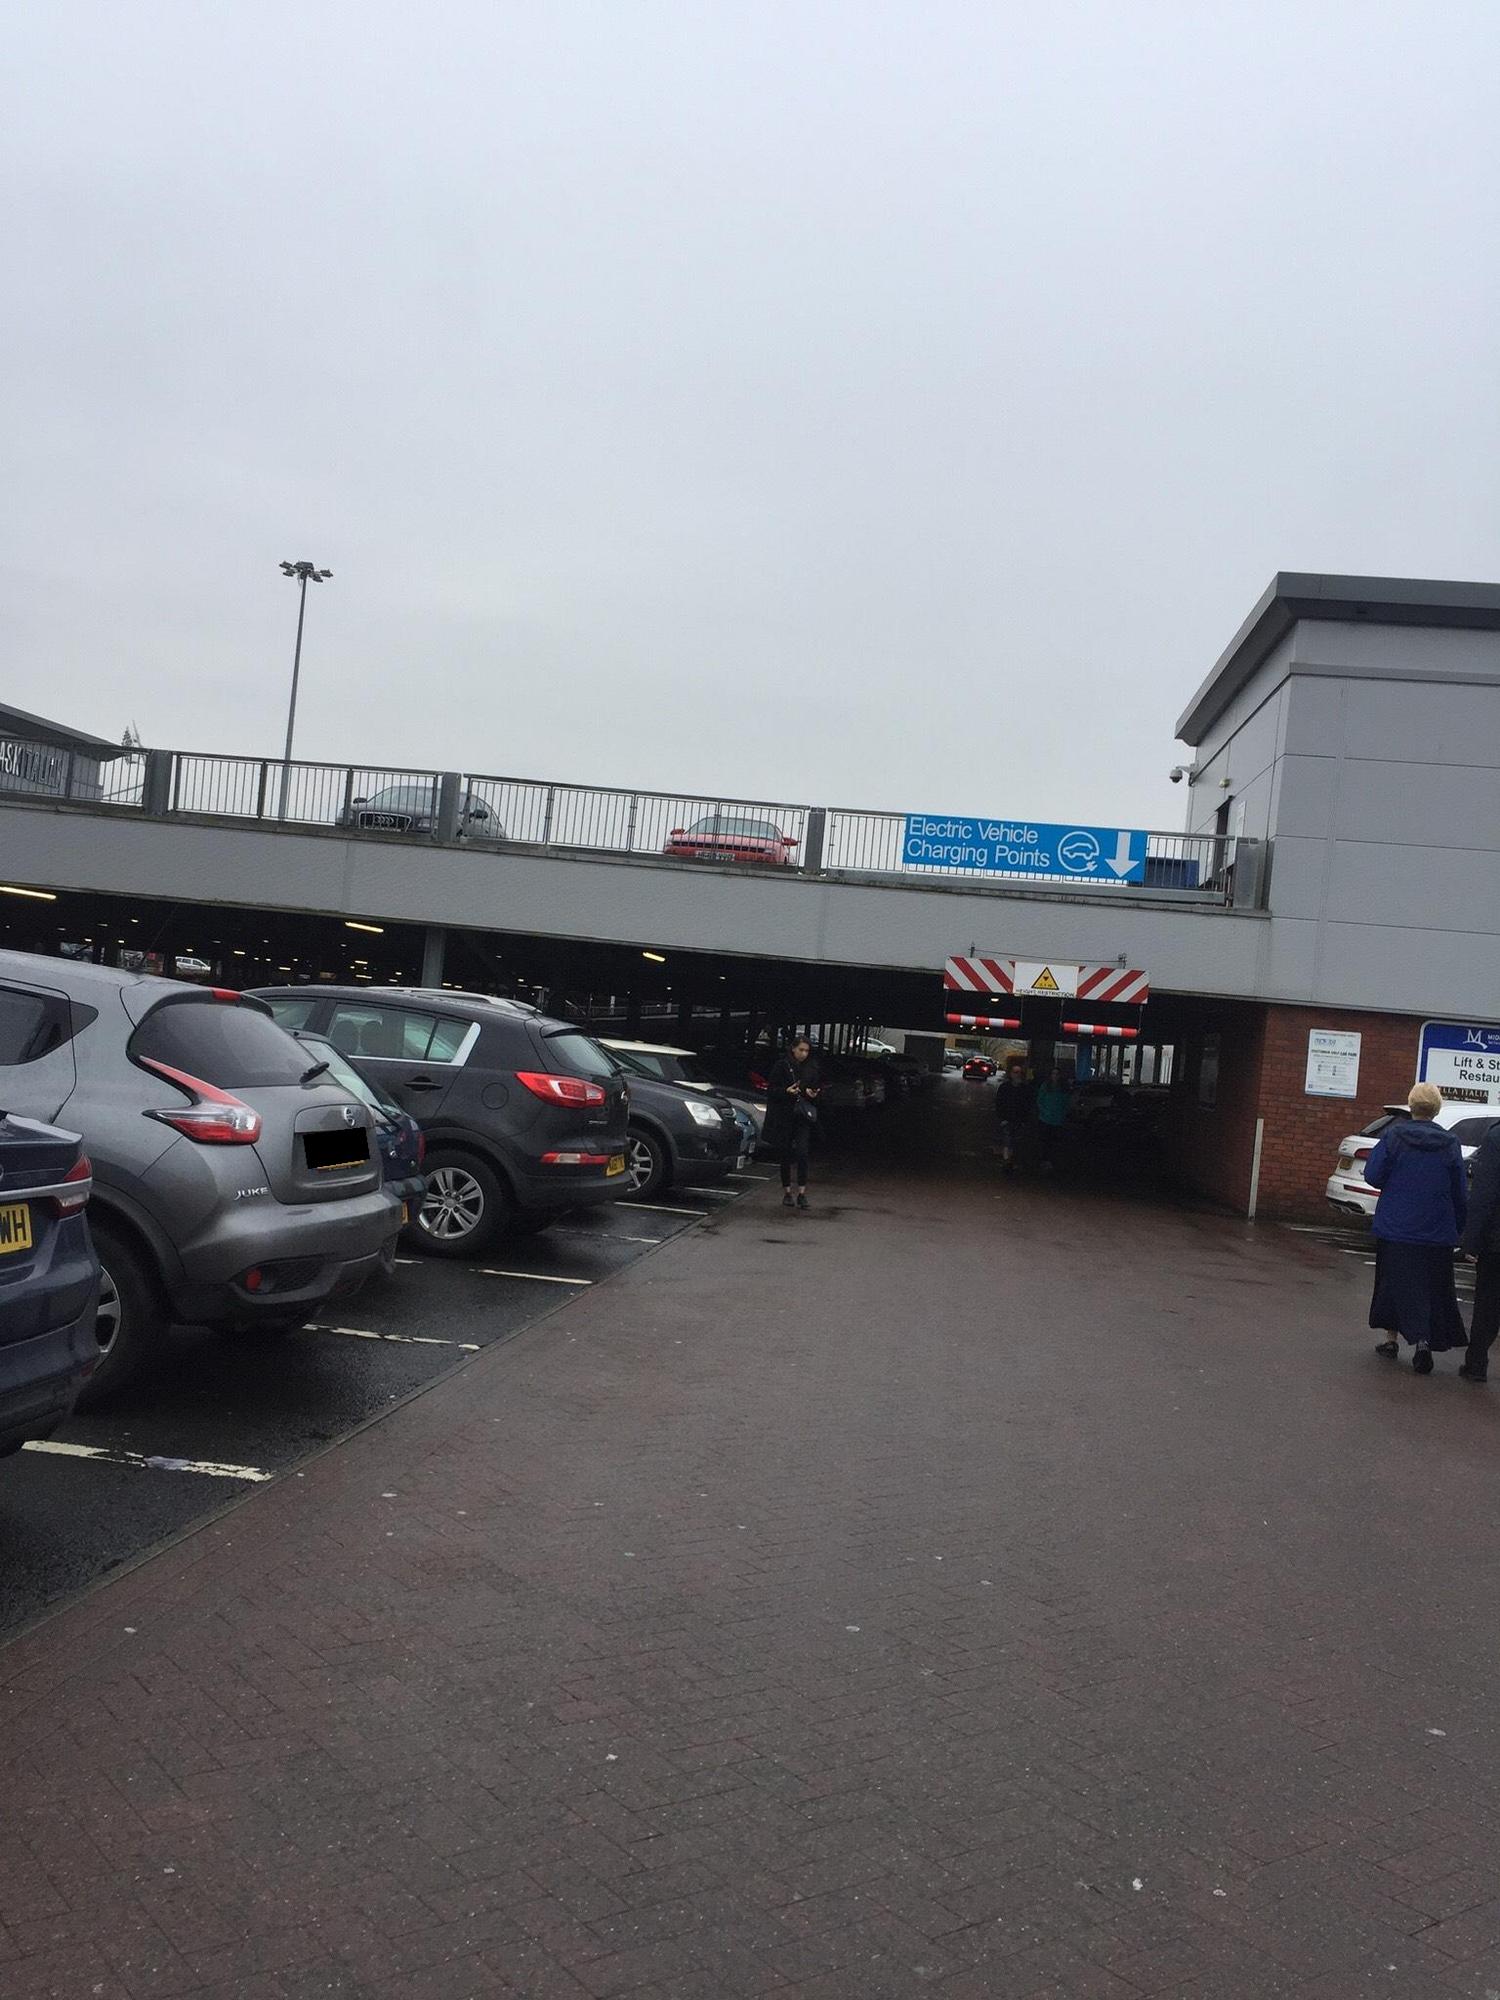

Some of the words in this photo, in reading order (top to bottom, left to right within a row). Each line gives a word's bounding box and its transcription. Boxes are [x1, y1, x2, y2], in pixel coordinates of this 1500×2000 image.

[0, 741, 21, 777] ASK
[909, 817, 972, 837] Electric
[978, 822, 1038, 845] Vehicle
[907, 839, 988, 866] Charging
[995, 846, 1050, 868] Points
[1454, 1056, 1473, 1068] Lift
[1475, 1058, 1485, 1069] &
[1461, 1088, 1488, 1097] ITALIA
[234, 1187, 270, 1200] JUKE
